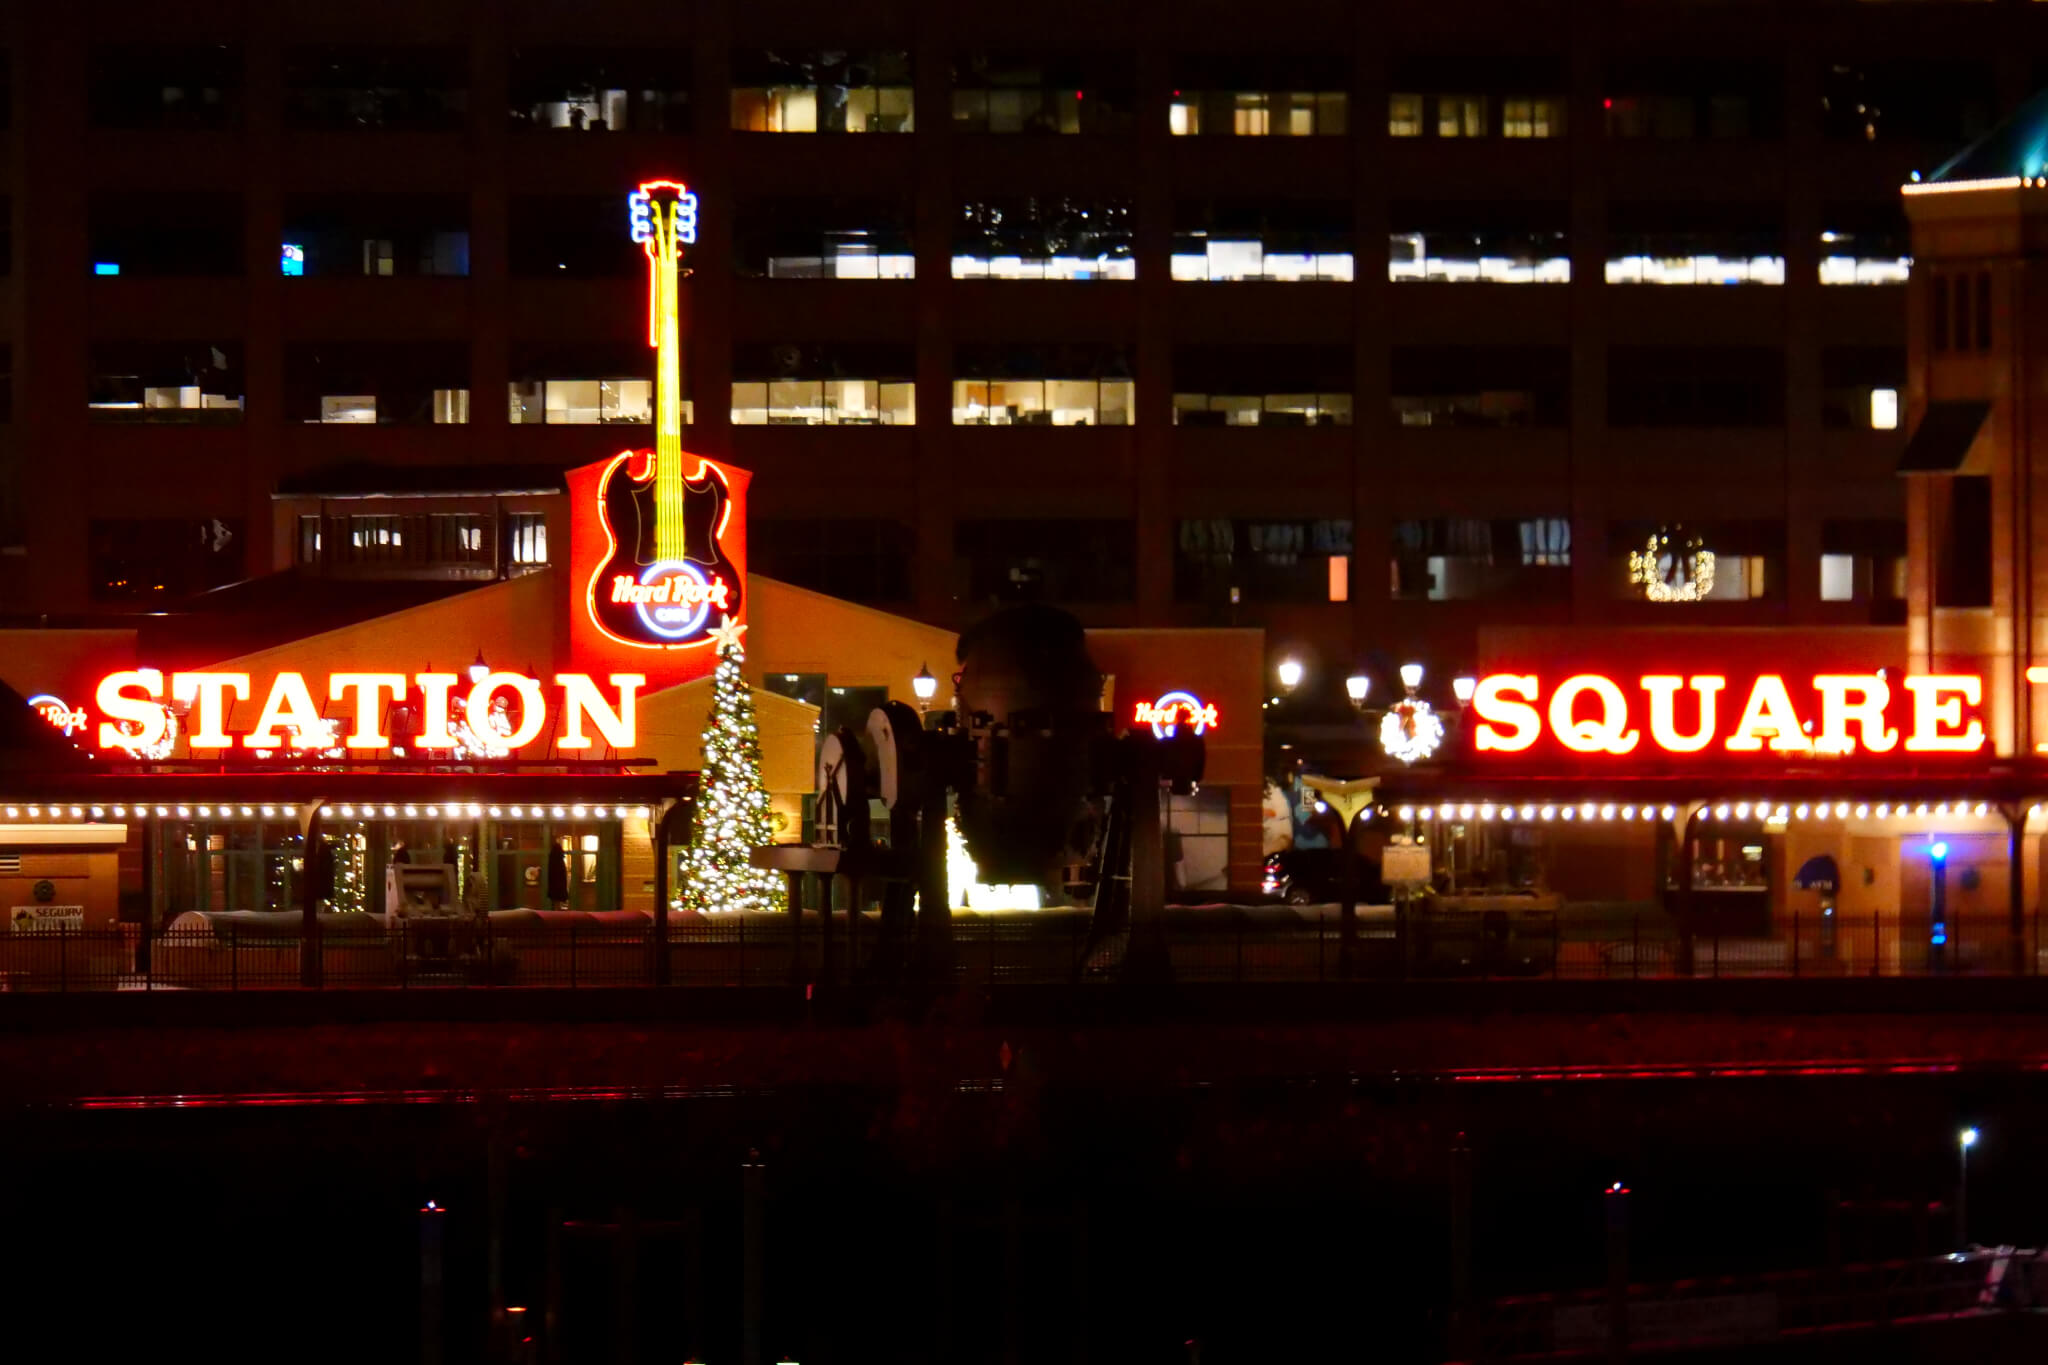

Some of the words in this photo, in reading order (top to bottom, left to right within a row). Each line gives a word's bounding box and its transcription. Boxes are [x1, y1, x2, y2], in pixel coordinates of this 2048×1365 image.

[611, 575, 672, 603] Hard
[672, 575, 728, 608] Rock
[47, 706, 88, 730] Rock
[96, 671, 646, 749] STATION
[1135, 702, 1178, 723] Hard
[1472, 673, 1984, 755] SQUARE
